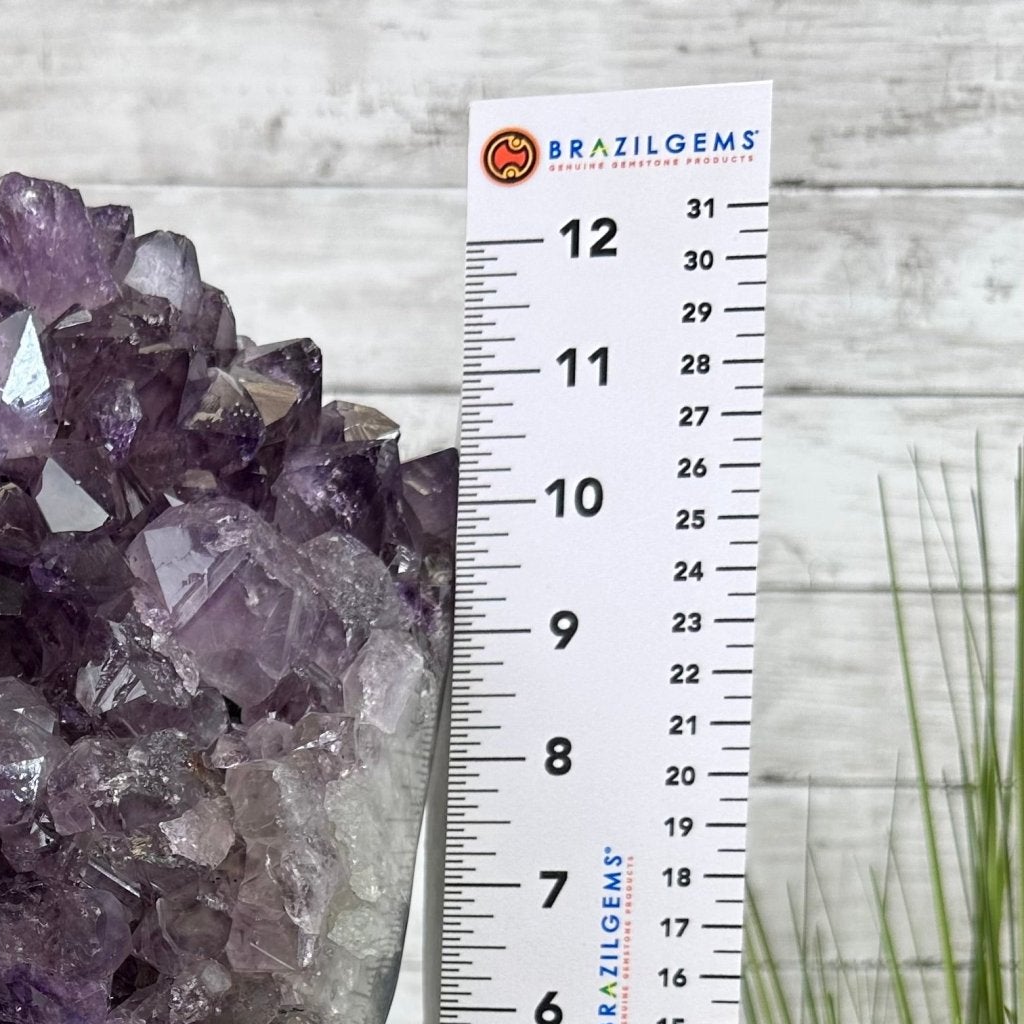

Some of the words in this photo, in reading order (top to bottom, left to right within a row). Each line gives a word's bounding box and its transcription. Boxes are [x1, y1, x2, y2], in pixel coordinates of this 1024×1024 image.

[549, 130, 757, 160] BRAZILGEMS
[549, 162, 605, 172] GENUINE
[612, 159, 679, 169] GEMSTONE
[686, 155, 754, 165] PRODUCTS
[687, 197, 715, 219] 31
[559, 217, 618, 259] 12
[683, 249, 714, 272] 30
[681, 301, 713, 324] 29
[556, 346, 609, 387] 11
[680, 353, 711, 375] 28
[679, 405, 710, 427] 27
[677, 457, 708, 479] 26
[545, 476, 604, 518] 10
[675, 509, 706, 530] 25
[673, 560, 704, 582] 24
[549, 610, 579, 650] 9
[672, 612, 702, 633] 23
[670, 663, 700, 685] 22
[669, 714, 697, 735] 21
[544, 736, 572, 777] 8
[665, 765, 696, 786] 20
[664, 816, 694, 837] 19
[662, 867, 691, 888] 18
[539, 870, 569, 909] 7
[660, 917, 690, 938] 17
[658, 967, 687, 988] 16
